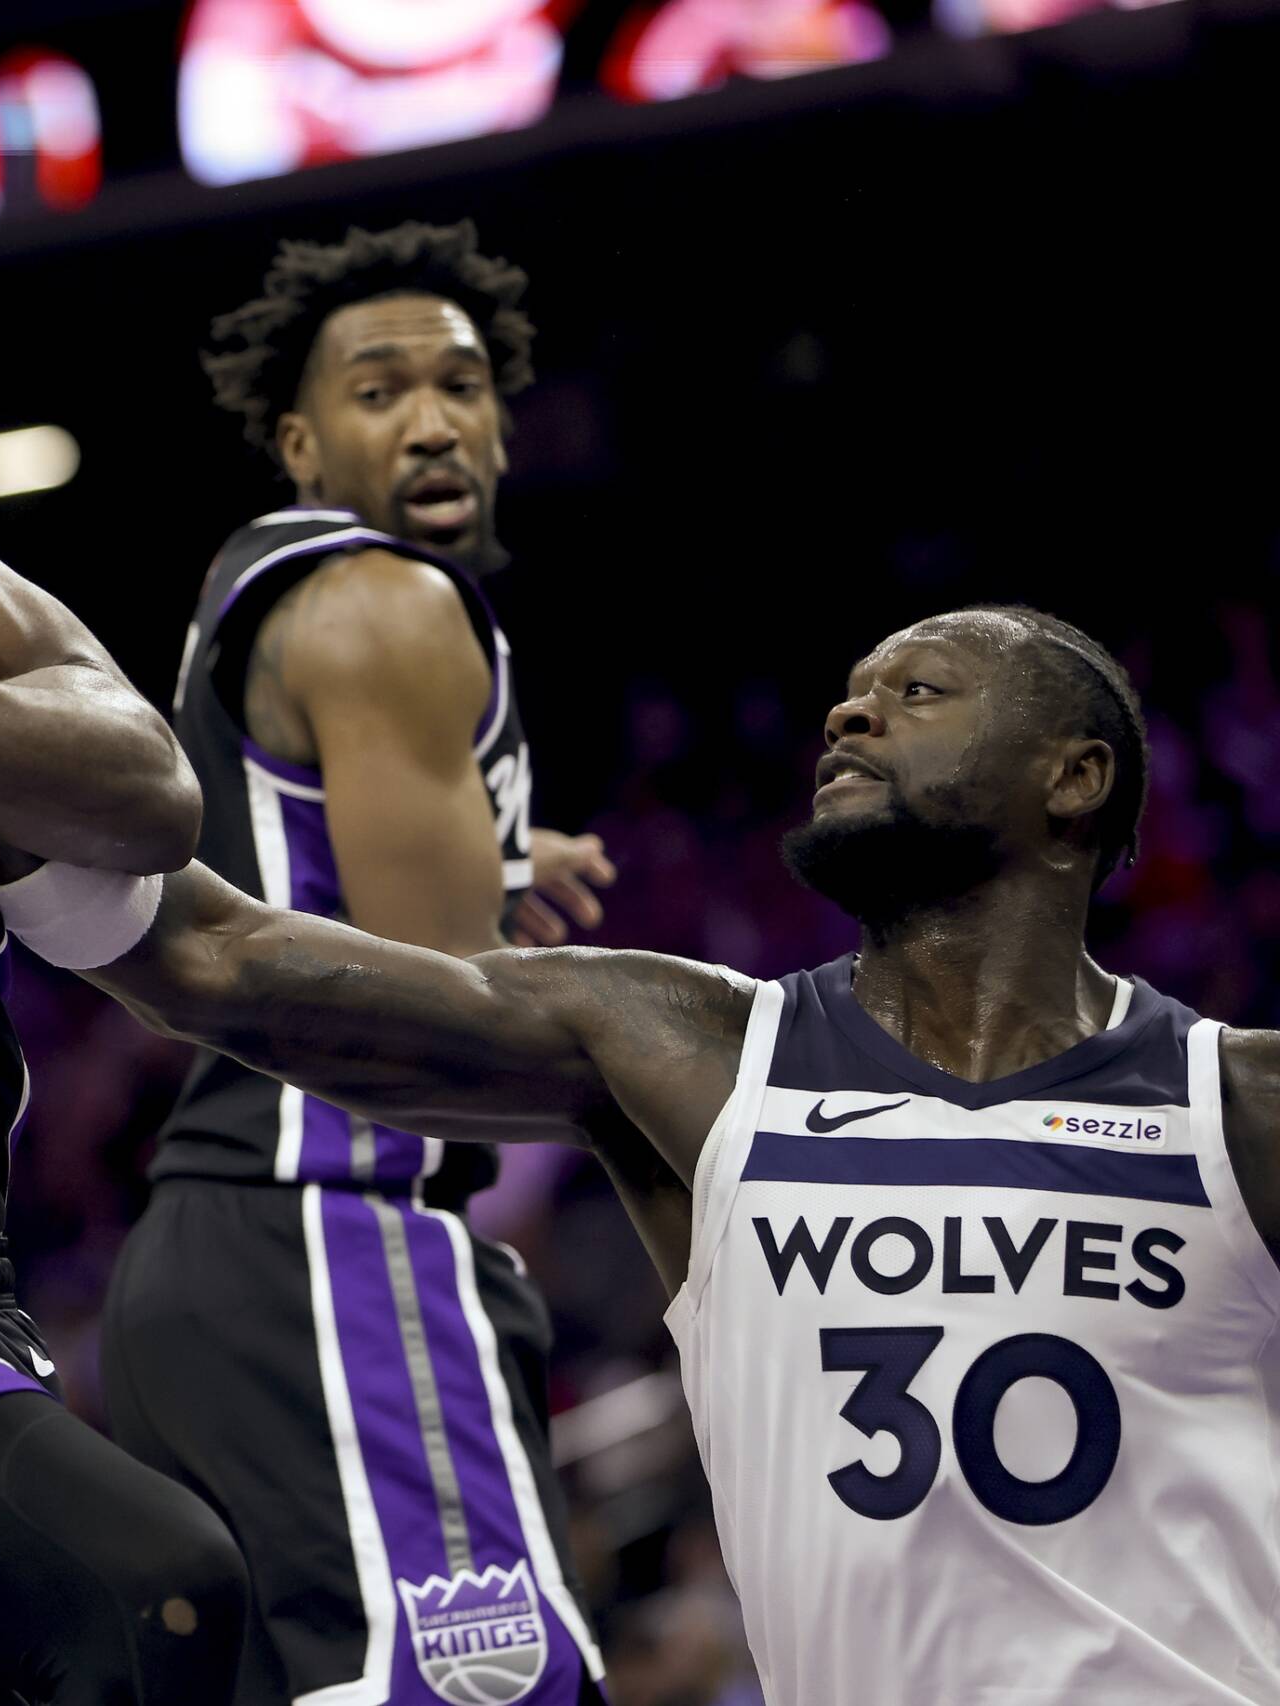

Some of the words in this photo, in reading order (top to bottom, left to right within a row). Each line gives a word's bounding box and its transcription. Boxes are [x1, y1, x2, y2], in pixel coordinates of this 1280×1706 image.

[1066, 1117, 1161, 1140] sezzle
[752, 1216, 1186, 1310] WOLVES
[819, 1326, 1121, 1526] 30
[422, 1620, 539, 1660] KINGS
